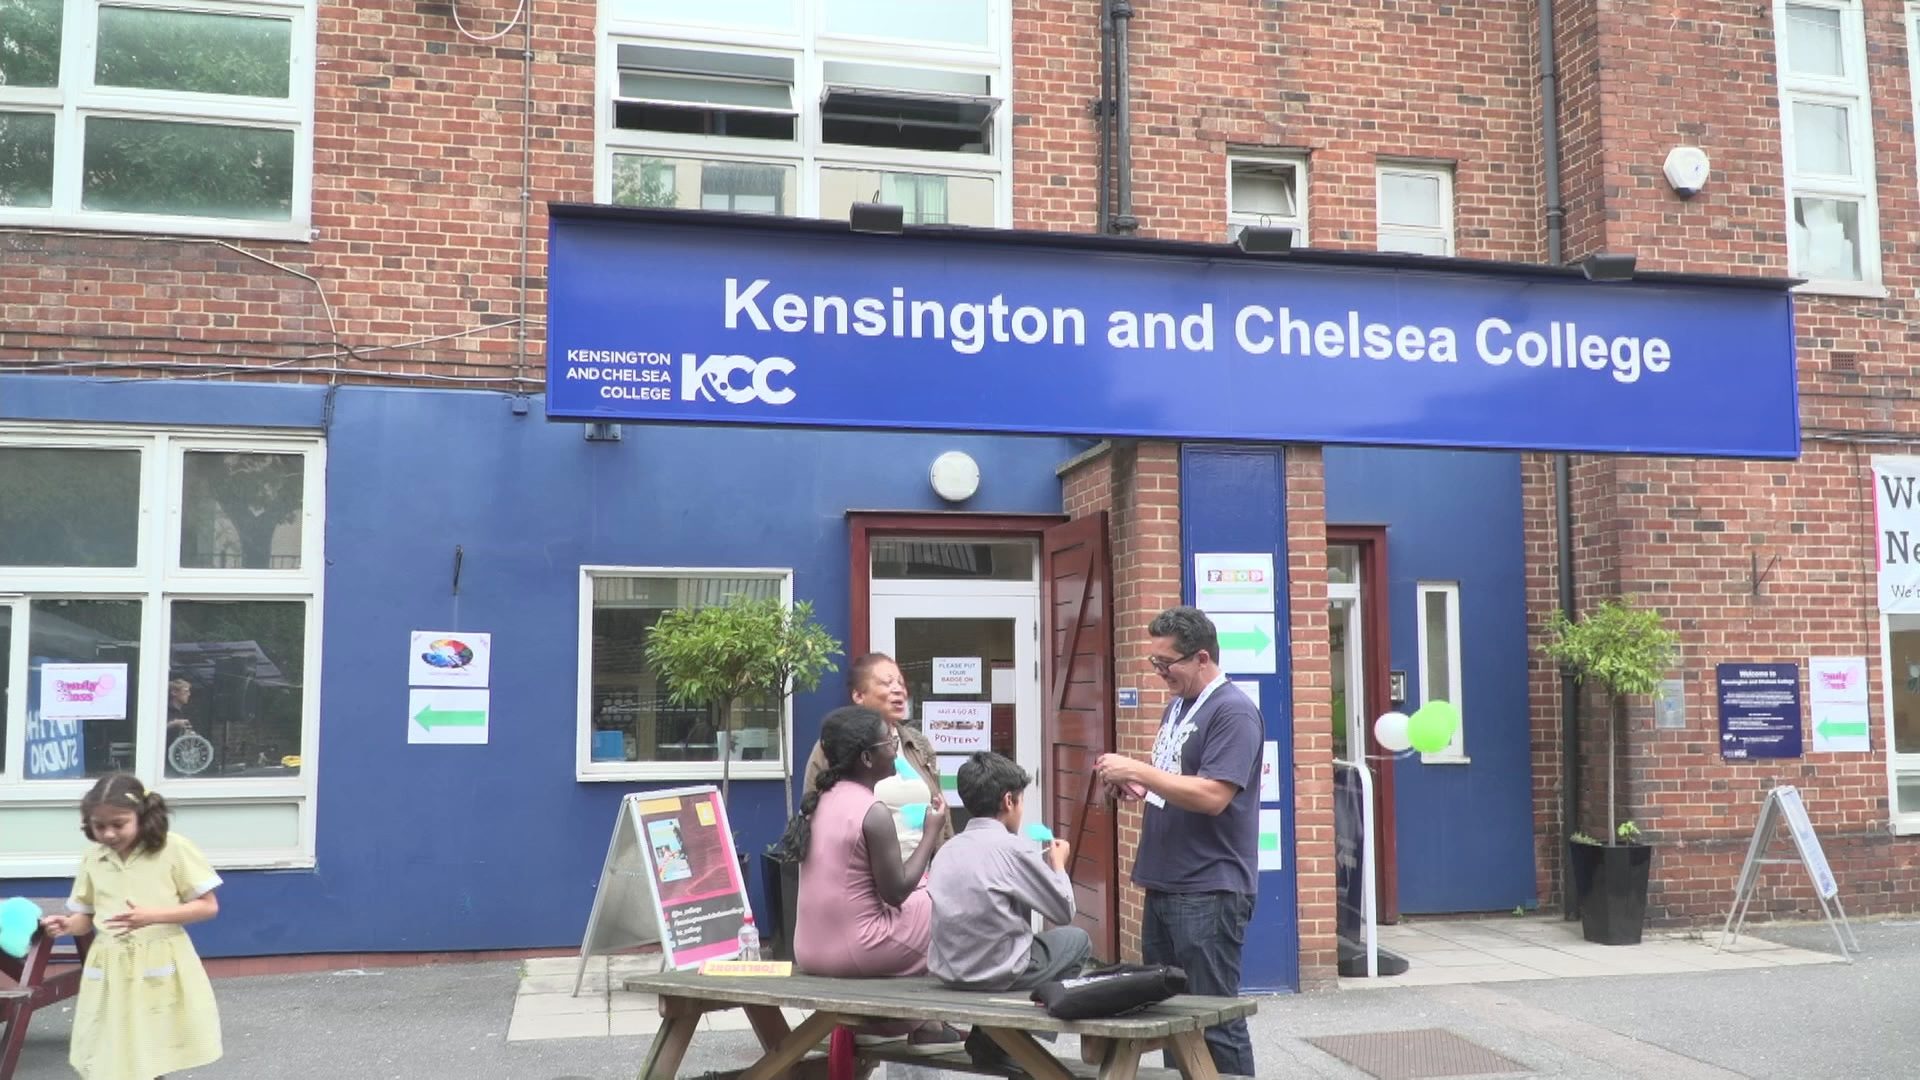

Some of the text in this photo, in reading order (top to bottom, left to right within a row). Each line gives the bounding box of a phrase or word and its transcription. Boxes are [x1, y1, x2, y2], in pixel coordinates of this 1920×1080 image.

[724, 278, 1671, 383] Kensington and Chelsea College
[567, 349, 671, 366] KENSINGTON
[566, 367, 672, 383] AND CHELSEA
[600, 385, 671, 401] COLLEGE
[1880, 474, 1920, 509] W
[935, 733, 980, 744] POTTERY
